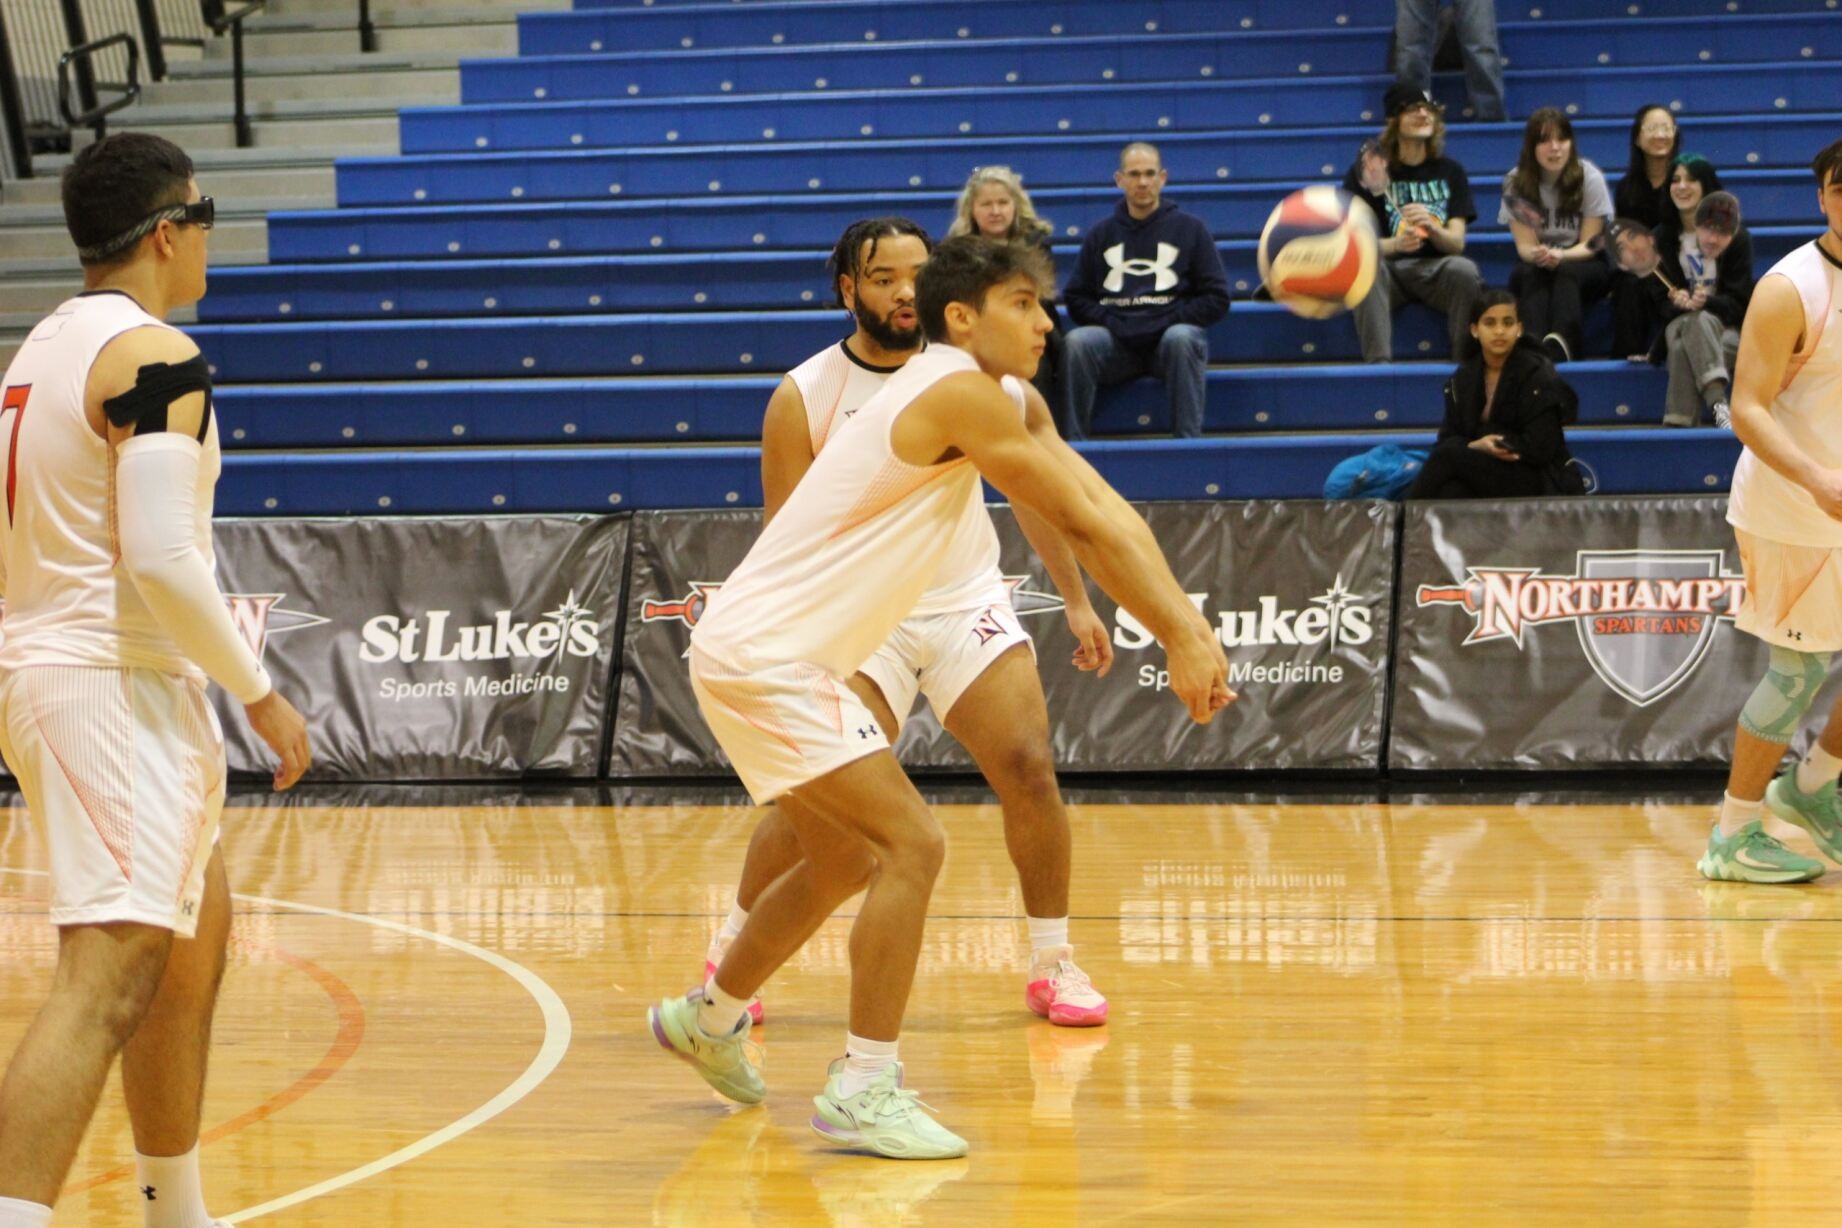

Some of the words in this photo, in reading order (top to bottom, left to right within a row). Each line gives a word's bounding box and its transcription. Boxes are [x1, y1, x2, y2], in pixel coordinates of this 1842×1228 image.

[1468, 568, 1747, 648] NORTHAMPT
[1594, 616, 1701, 634] SPARTANS
[1227, 661, 1344, 684] Medicine
[379, 676, 456, 702] Sports
[464, 672, 570, 697] Medicine
